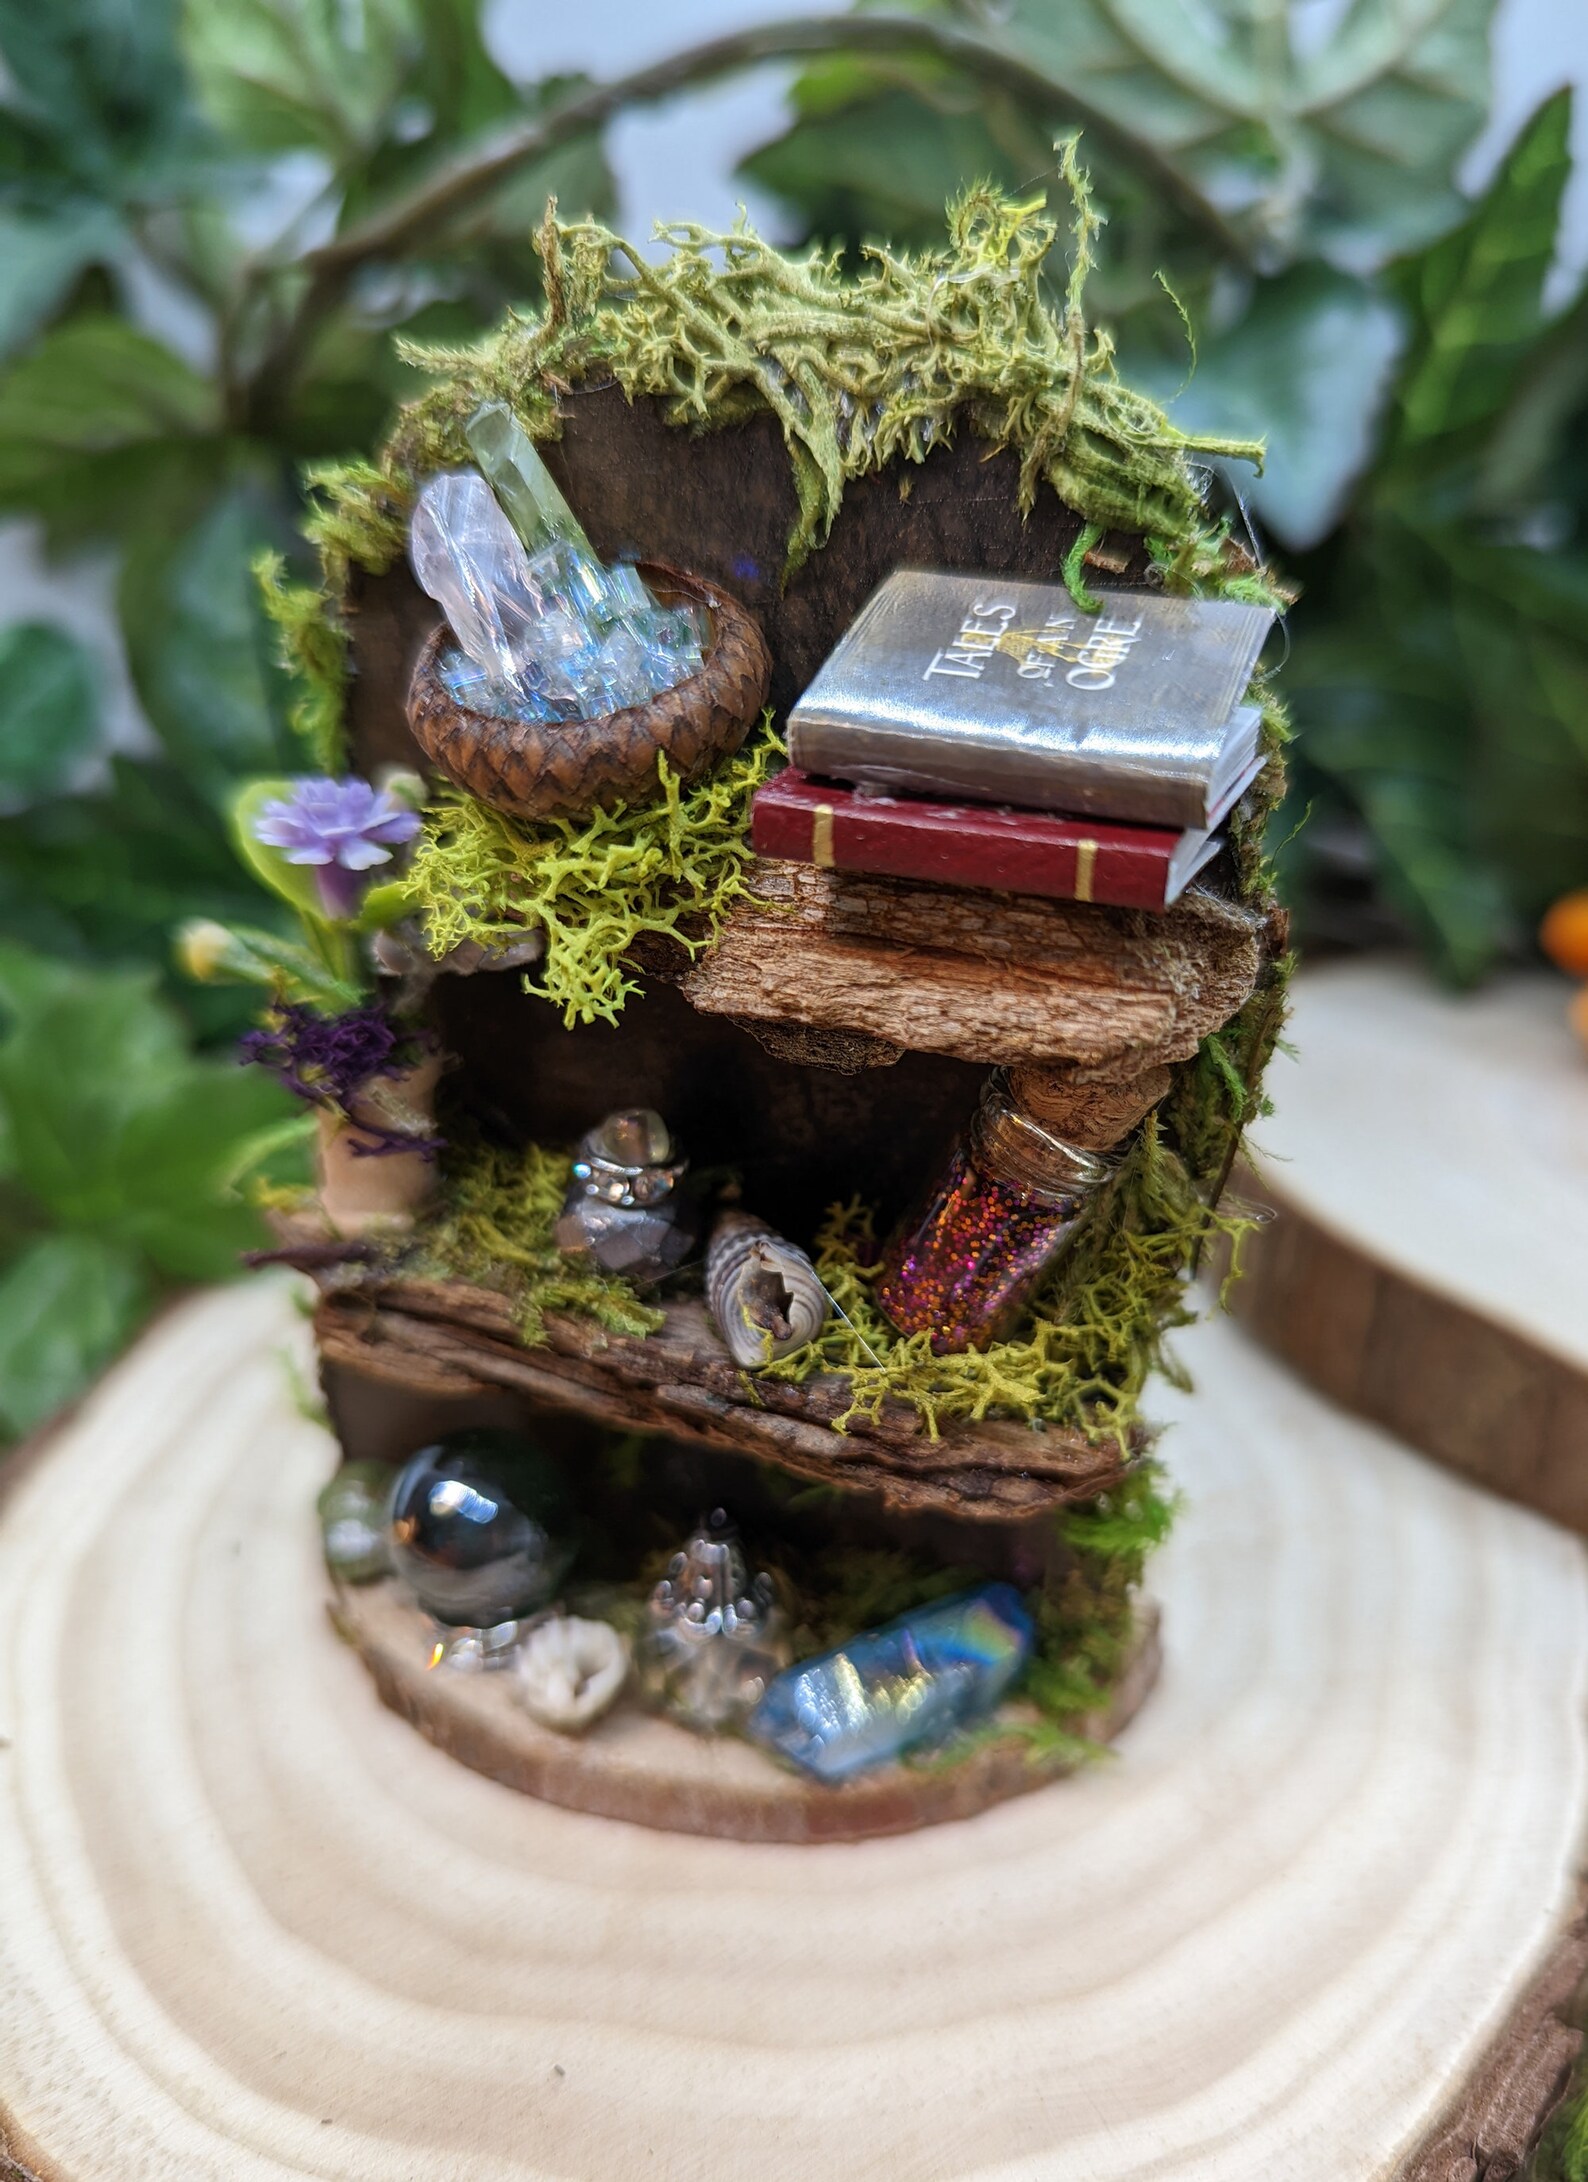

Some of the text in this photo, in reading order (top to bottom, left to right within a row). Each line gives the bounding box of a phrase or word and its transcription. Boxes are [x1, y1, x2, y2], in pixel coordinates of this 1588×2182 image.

[922, 604, 1016, 681] TALES
[1017, 613, 1077, 679] OF AN
[1066, 614, 1142, 691] OGRE
